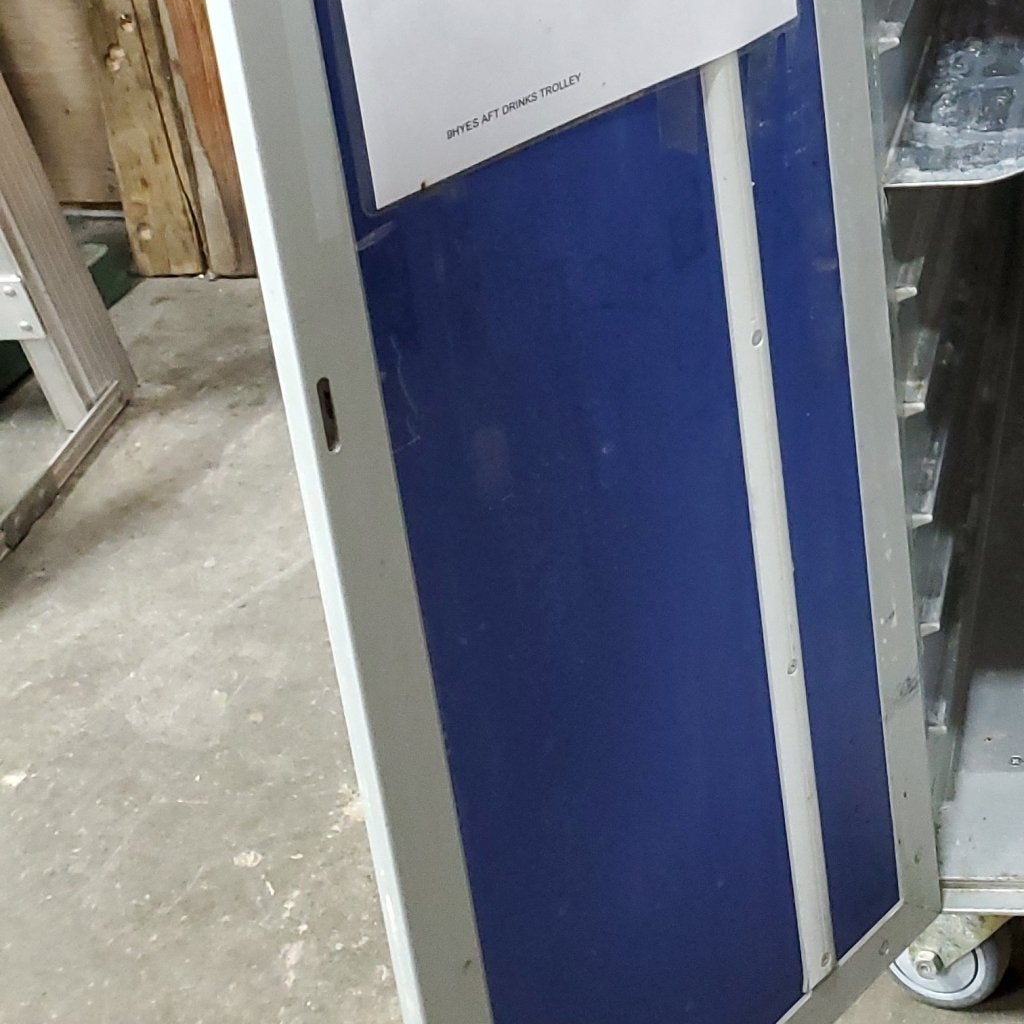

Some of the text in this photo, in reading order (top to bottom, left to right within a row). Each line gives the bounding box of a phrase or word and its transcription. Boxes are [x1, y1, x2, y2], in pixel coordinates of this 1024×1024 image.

[481, 107, 500, 125] AFT
[501, 91, 538, 116] DRINKS
[540, 73, 581, 98] TROLLEY
